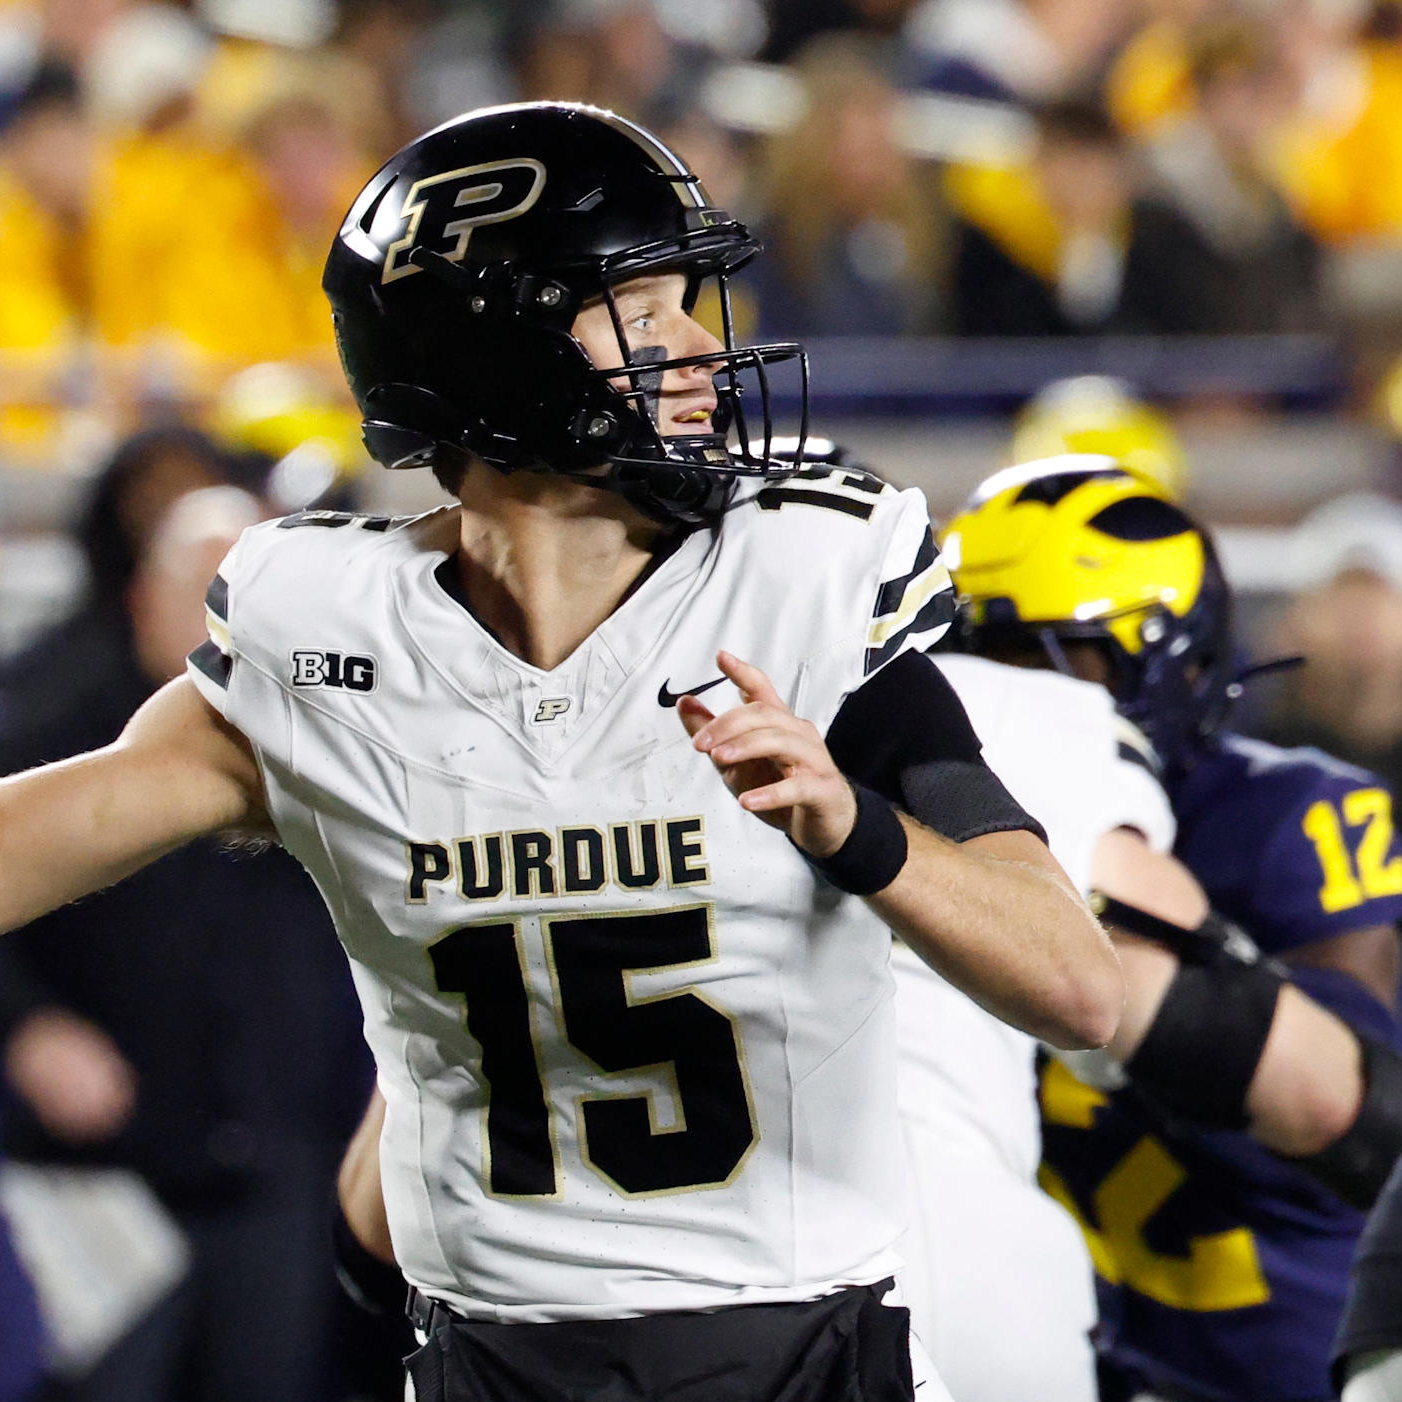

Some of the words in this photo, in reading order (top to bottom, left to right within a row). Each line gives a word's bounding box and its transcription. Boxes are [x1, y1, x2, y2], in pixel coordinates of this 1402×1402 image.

[382, 157, 547, 285] P
[534, 698, 571, 722] P
[406, 815, 711, 905] PURDUE
[424, 901, 761, 1201] 15
